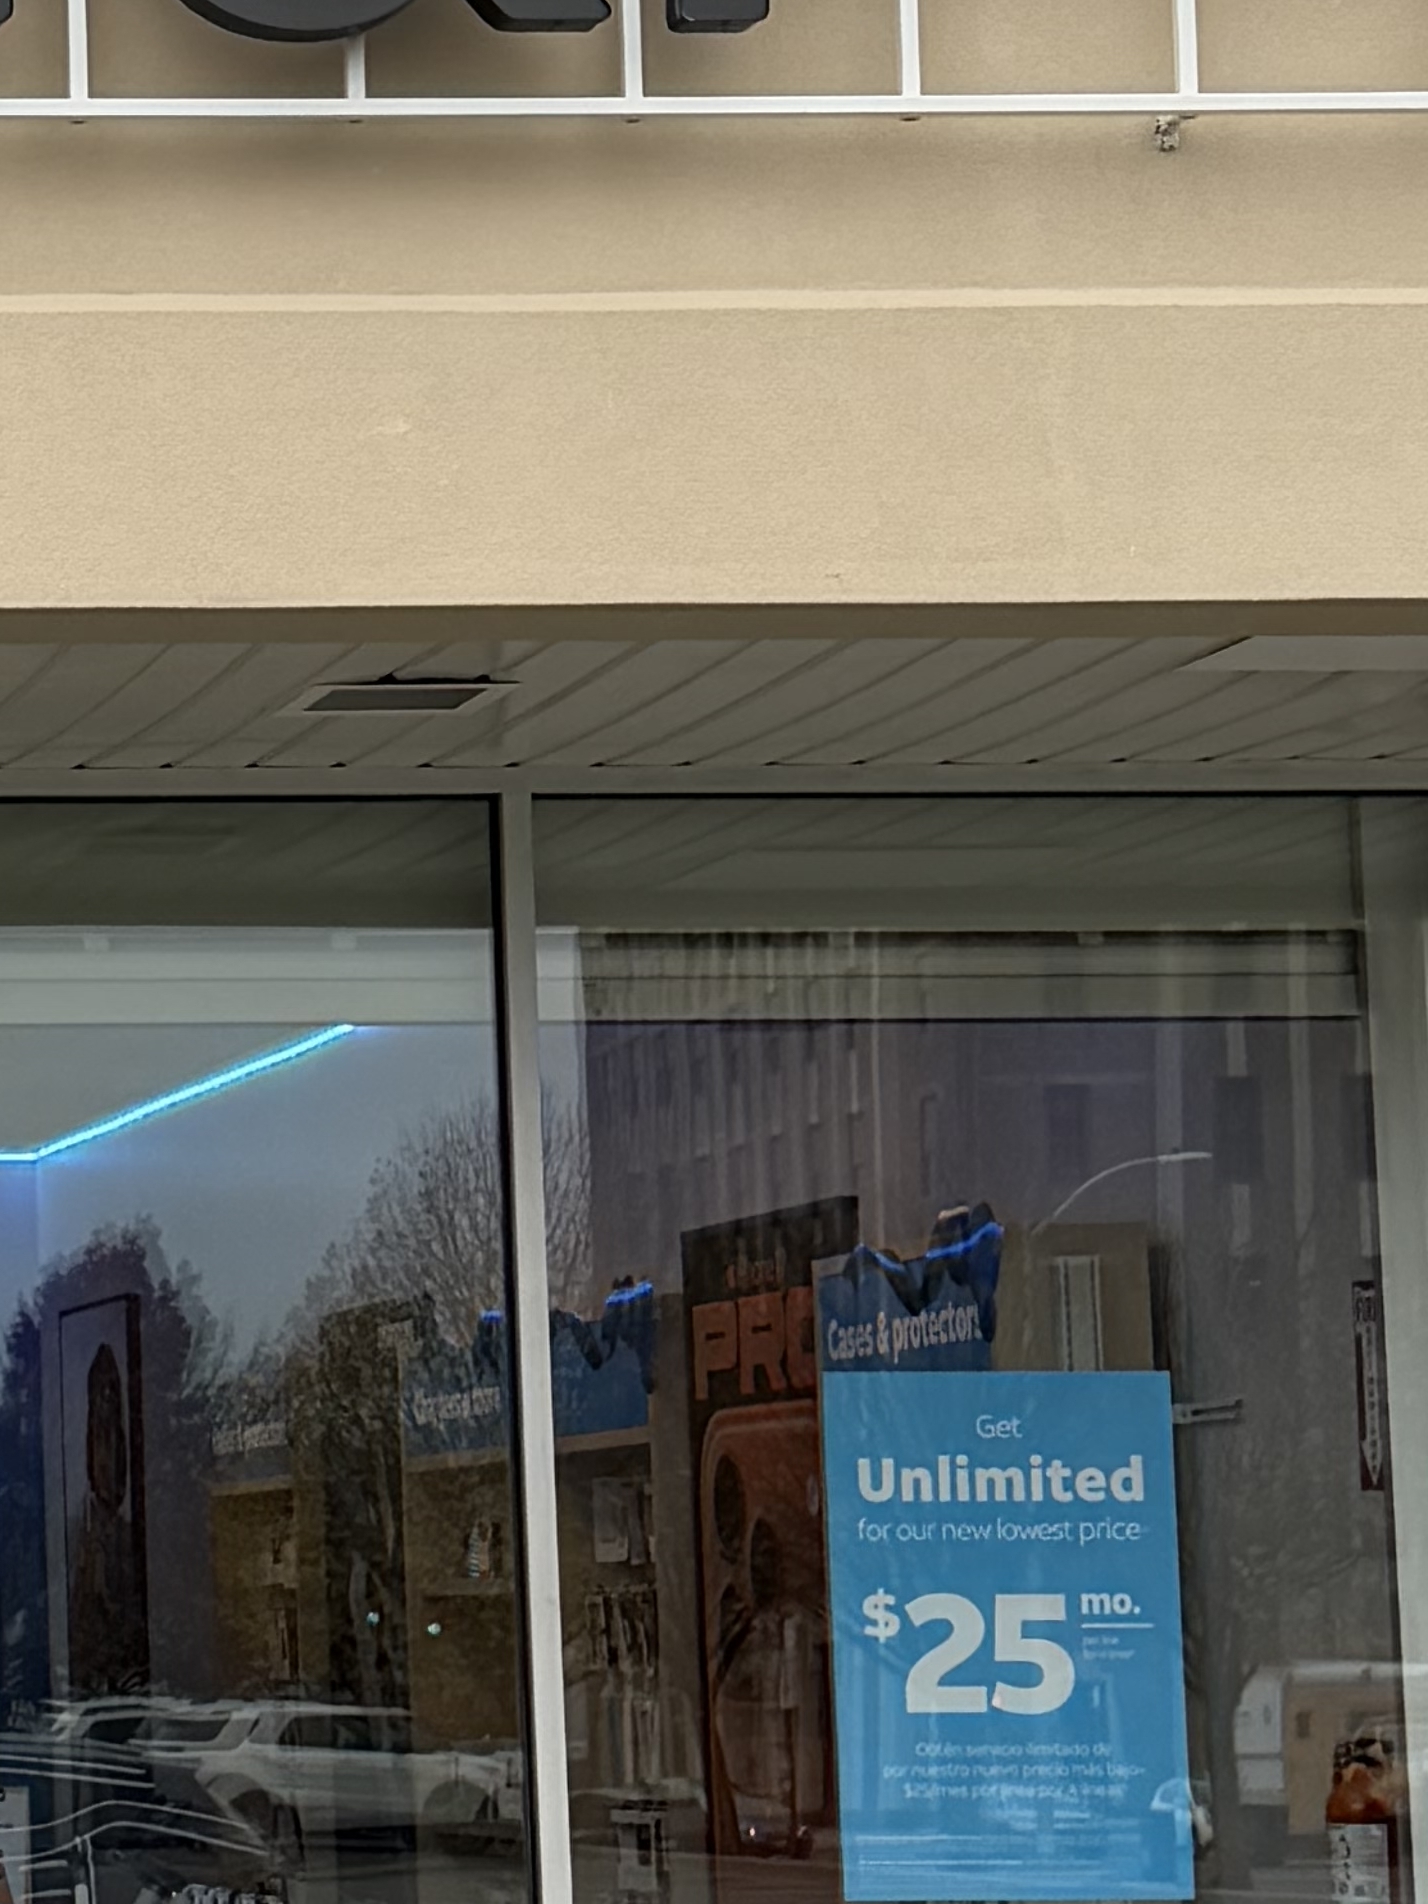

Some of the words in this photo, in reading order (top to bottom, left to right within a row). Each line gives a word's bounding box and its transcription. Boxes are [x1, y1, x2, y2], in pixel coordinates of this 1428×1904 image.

[828, 1318, 873, 1361] Cases
[876, 1310, 890, 1355] &
[976, 1415, 1023, 1438] Get
[857, 1454, 1145, 1503] Unlimited
[858, 1517, 892, 1542] for
[896, 1522, 935, 1541] our
[942, 1522, 992, 1541] new
[997, 1517, 1072, 1541] lowest
[1080, 1592, 1141, 1615] mo.
